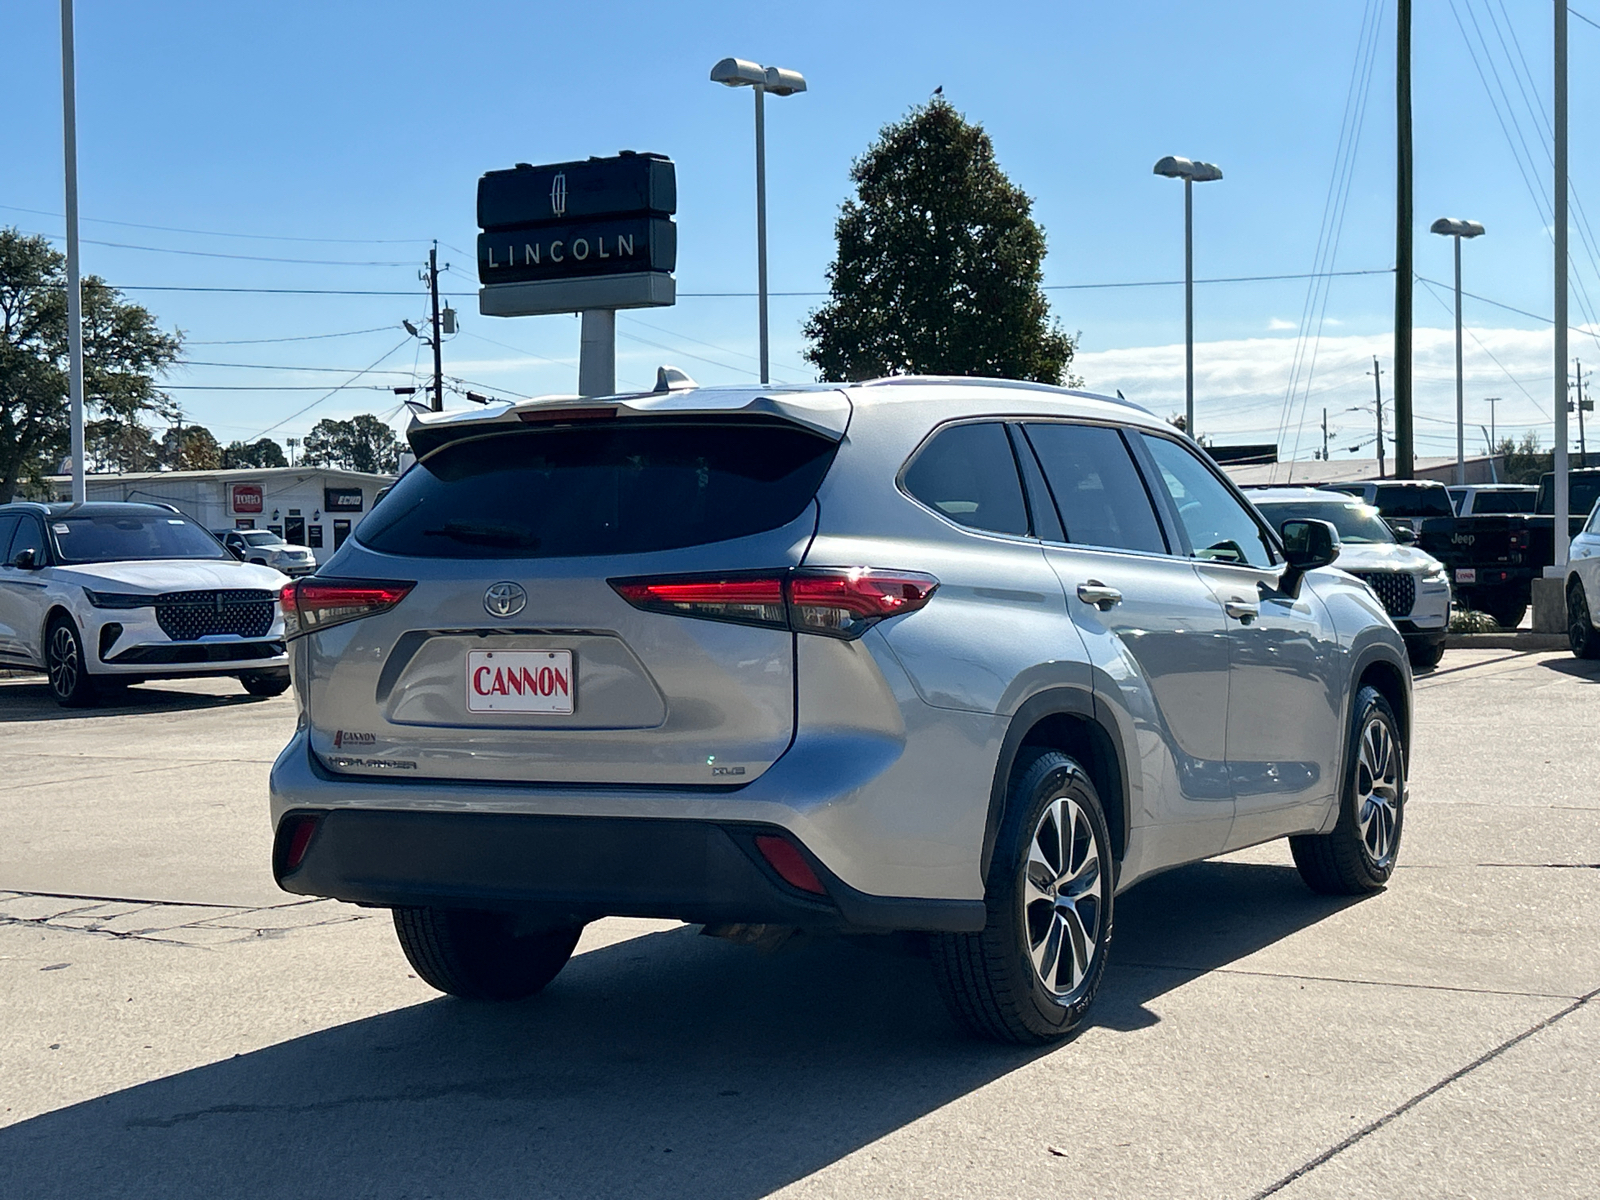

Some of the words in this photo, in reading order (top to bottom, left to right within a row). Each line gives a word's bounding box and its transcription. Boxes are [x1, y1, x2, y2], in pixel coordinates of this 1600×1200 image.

[488, 234, 634, 268] LINCOLN
[235, 494, 261, 504] TORO
[337, 495, 362, 505] ECHO
[1451, 533, 1475, 546] Jeep
[473, 666, 568, 697] CANNON
[343, 732, 376, 741] CANNON
